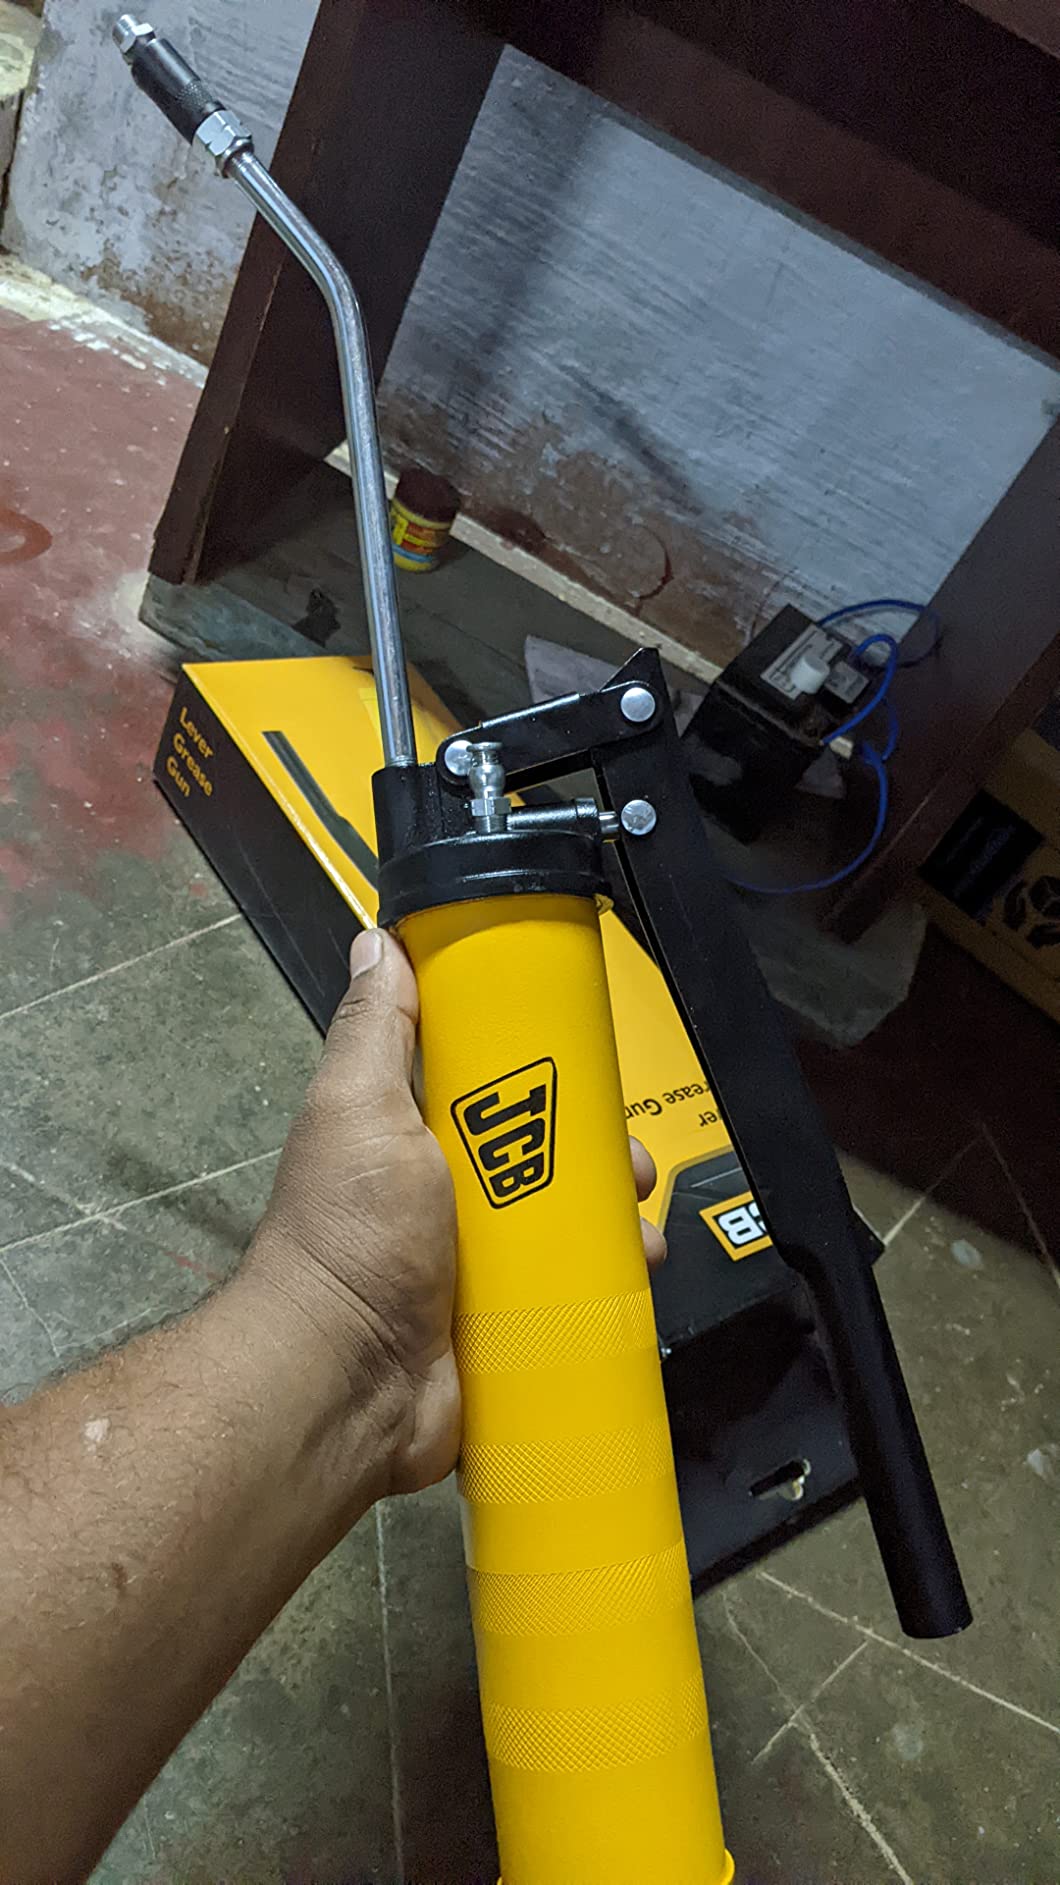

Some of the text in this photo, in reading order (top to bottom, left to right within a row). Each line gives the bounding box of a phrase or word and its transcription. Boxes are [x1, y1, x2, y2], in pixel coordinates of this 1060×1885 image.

[180, 706, 214, 758] Lever
[166, 756, 190, 797] Gun
[173, 732, 213, 797] Grease
[662, 1081, 709, 1104] rease
[463, 1084, 547, 1198] JCB
[698, 1111, 719, 1127] er
